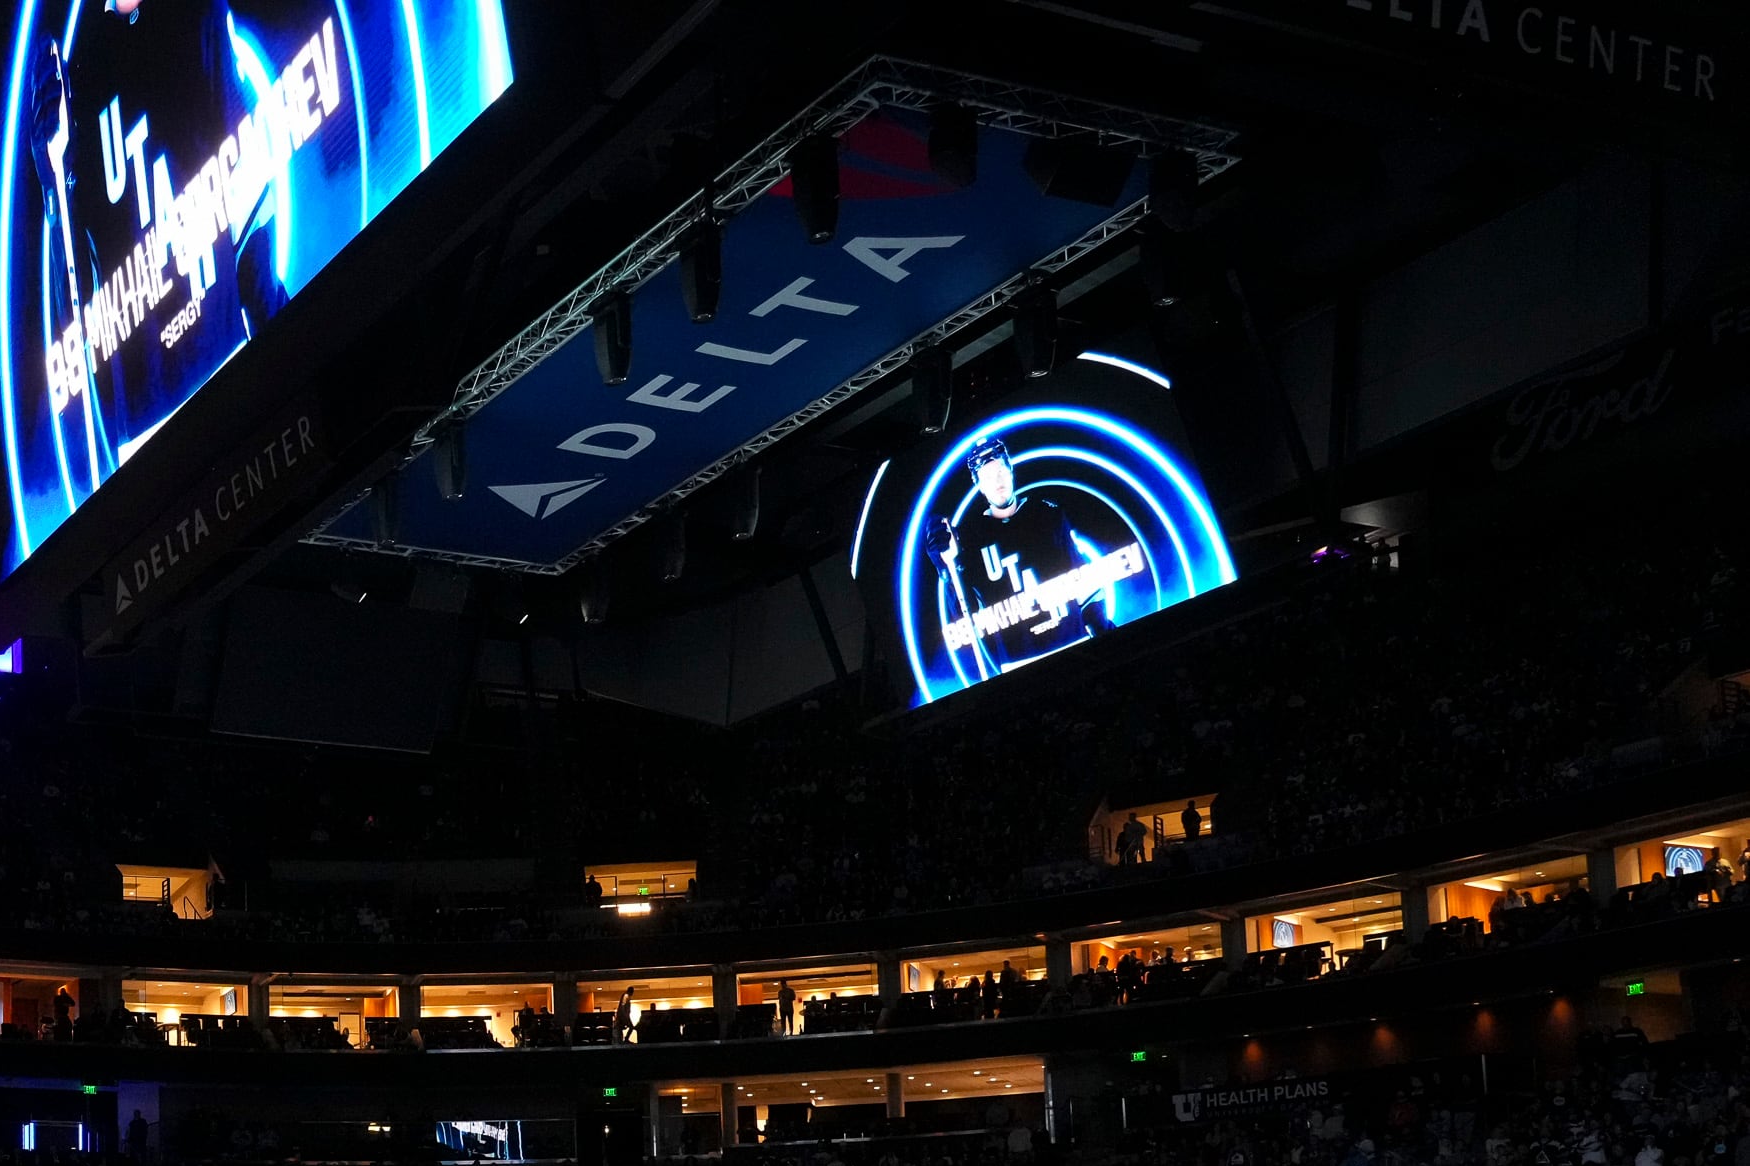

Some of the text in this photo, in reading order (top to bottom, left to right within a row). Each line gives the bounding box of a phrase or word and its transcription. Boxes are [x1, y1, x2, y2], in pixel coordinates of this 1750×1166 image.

[1512, 7, 1718, 100] CENTER
[84, 227, 173, 374] MIKHAIL
[555, 234, 968, 461] DELTA
[133, 415, 315, 593] DELTA CENTER
[1206, 1087, 1270, 1108] HEALTH
[1273, 1080, 1329, 1100] PLANS
